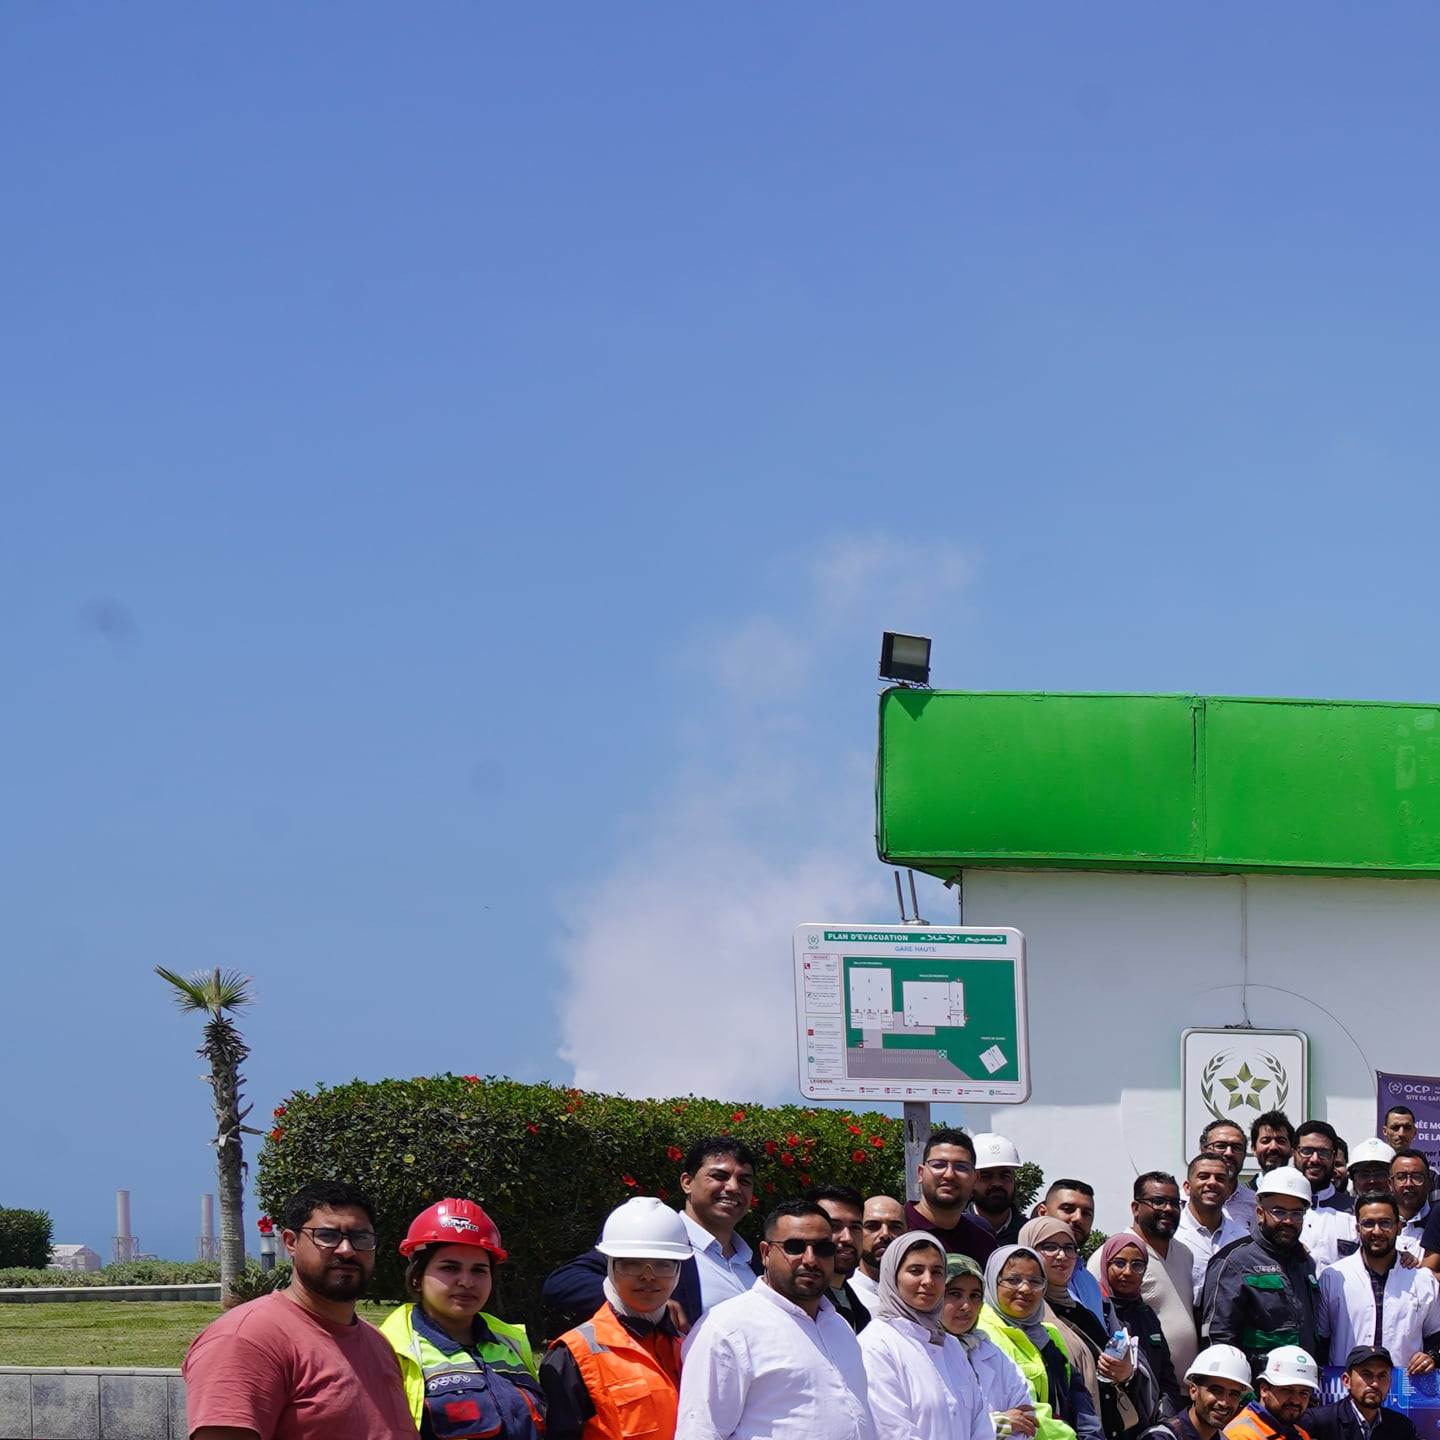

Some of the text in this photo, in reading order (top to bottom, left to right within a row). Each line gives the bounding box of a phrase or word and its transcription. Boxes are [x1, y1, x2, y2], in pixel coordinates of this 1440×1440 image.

[827, 932, 849, 940] PLAN
[1403, 1084, 1431, 1094] OCP
[1418, 1132, 1430, 1141] DE
